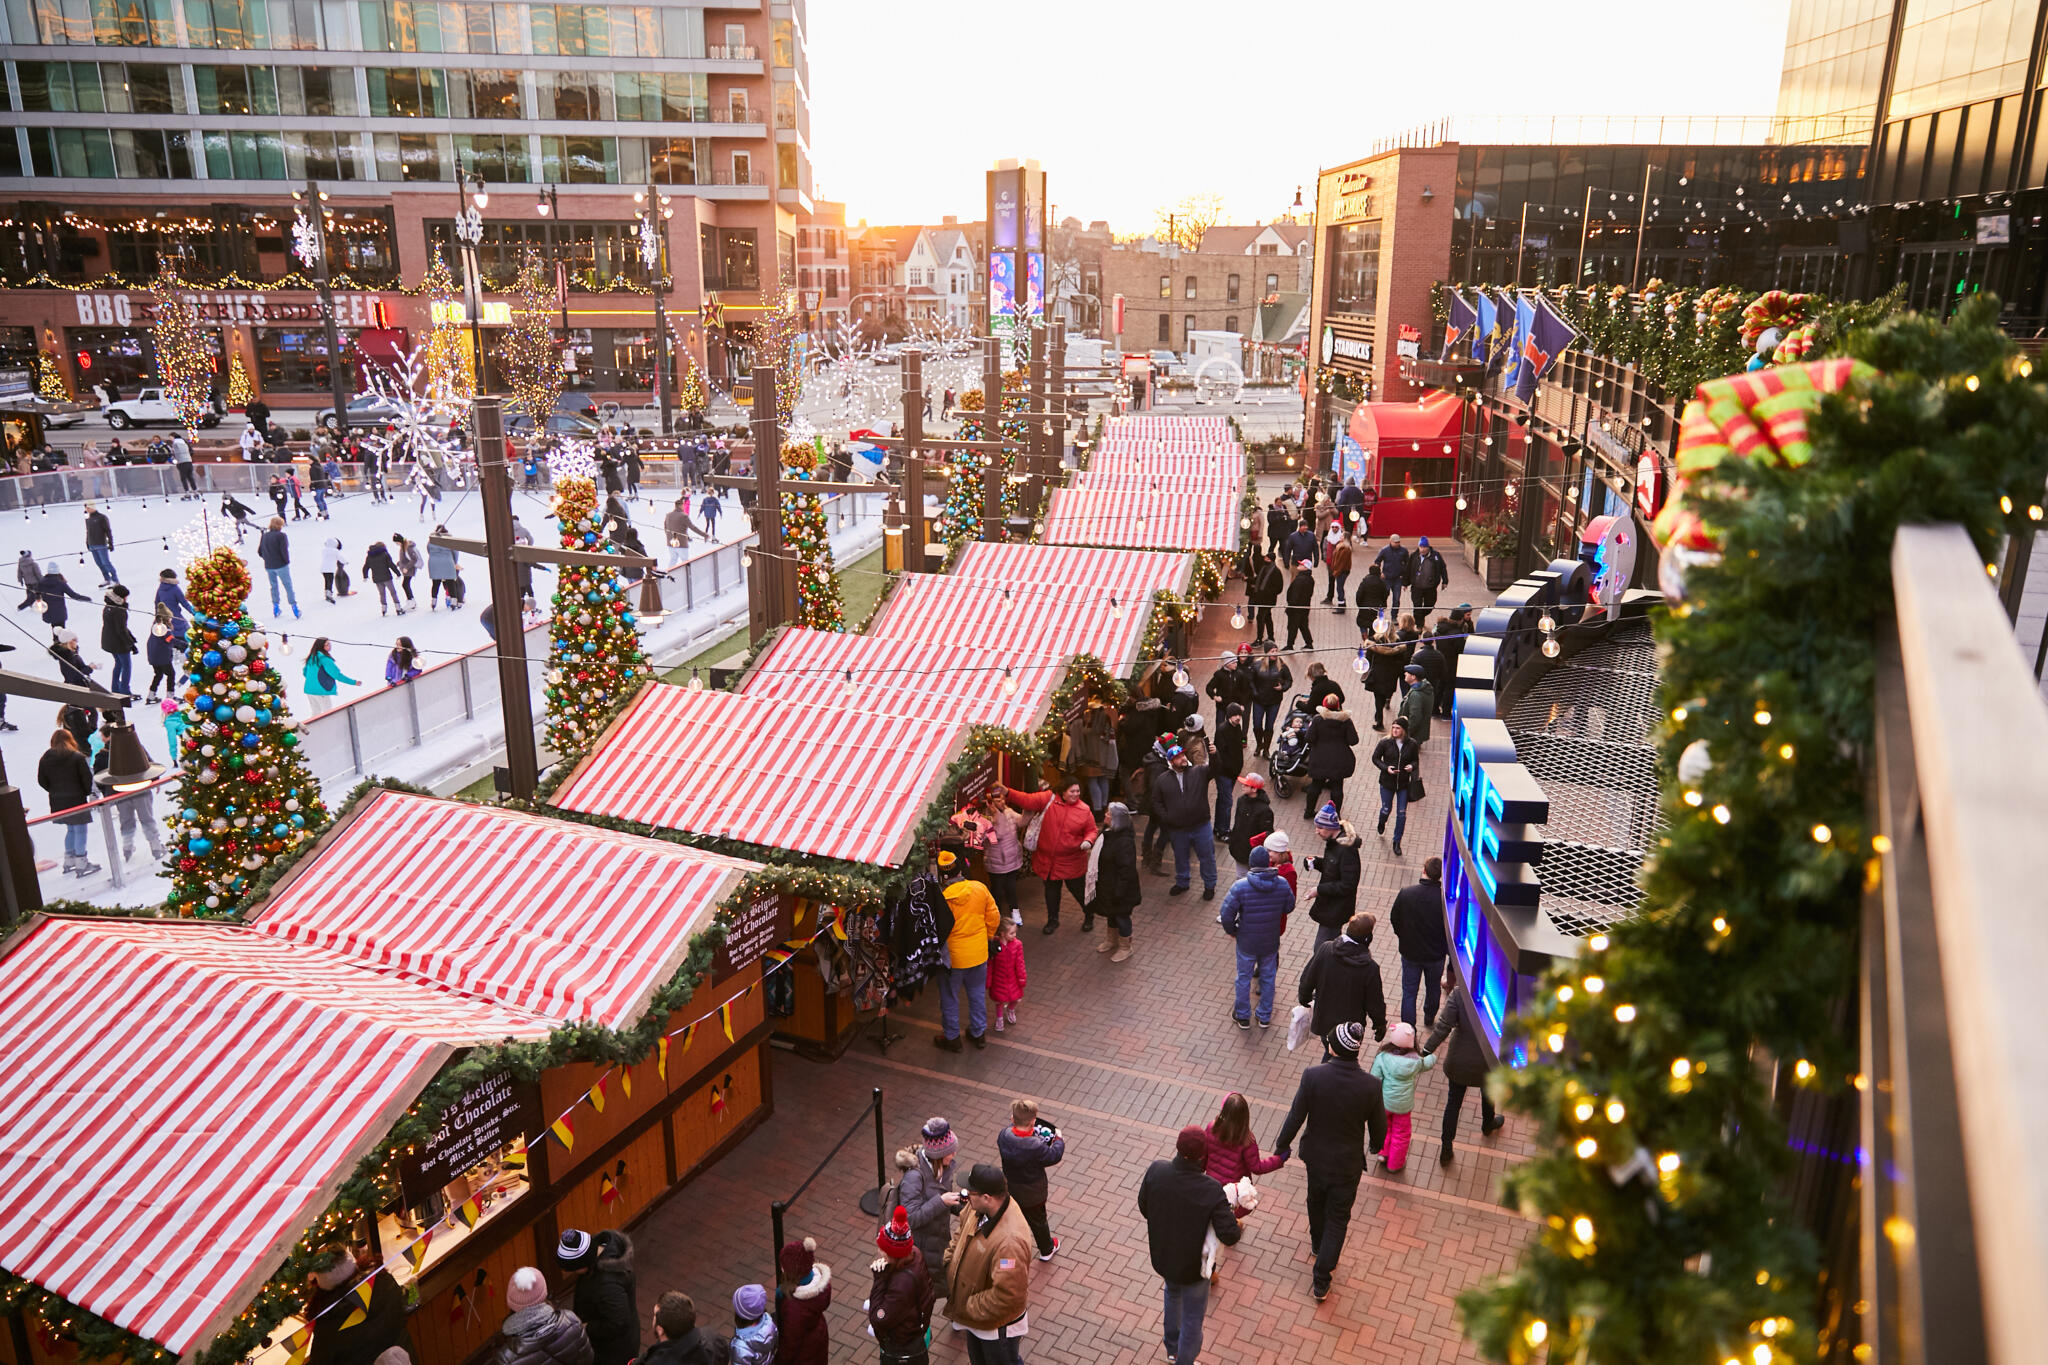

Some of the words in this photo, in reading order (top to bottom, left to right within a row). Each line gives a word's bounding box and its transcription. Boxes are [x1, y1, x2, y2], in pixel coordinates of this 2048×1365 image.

[76, 294, 132, 327] BBQ
[316, 294, 381, 327] EER
[1334, 338, 1370, 361] STARBUCKS
[743, 907, 778, 934] Chocolate
[749, 893, 779, 919] Belgian
[462, 1069, 512, 1111] Belgian
[454, 1086, 512, 1130] Chocolate
[420, 1159, 436, 1173] Hot
[437, 1134, 472, 1162] Chocolate
[472, 1116, 502, 1138] Drinks,
[448, 1151, 466, 1167] Mix
[467, 1143, 475, 1152] &
[476, 1127, 500, 1148] Ballen
[489, 1139, 502, 1151] USA
